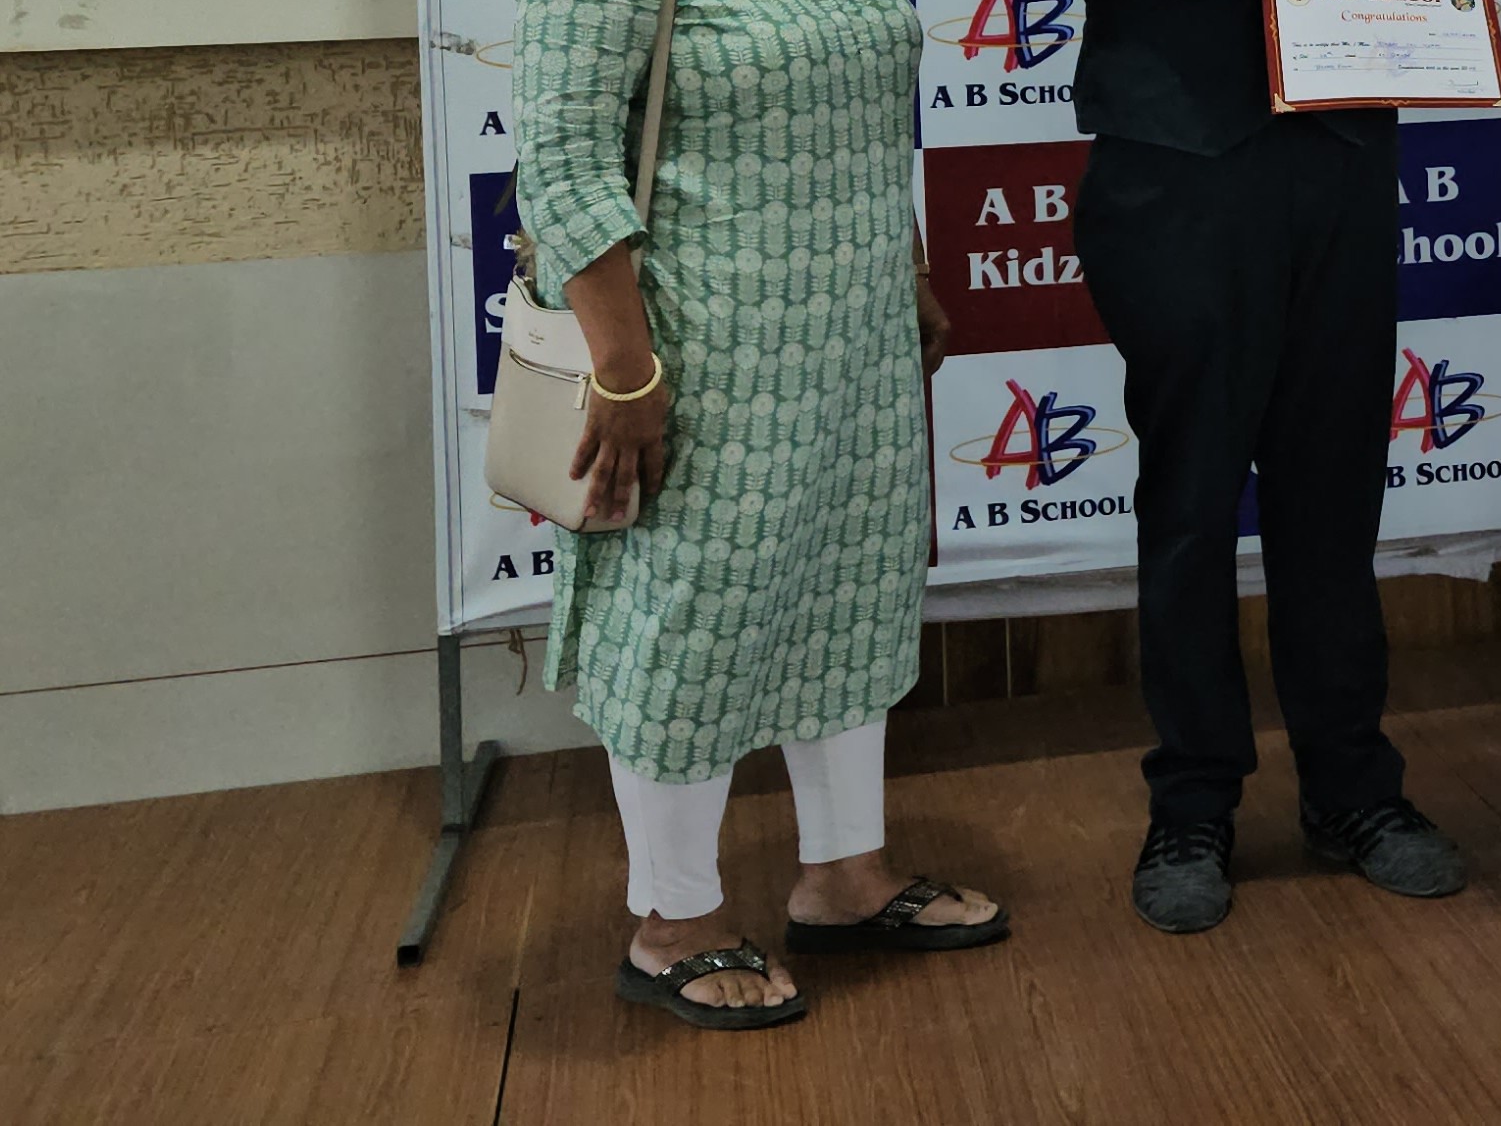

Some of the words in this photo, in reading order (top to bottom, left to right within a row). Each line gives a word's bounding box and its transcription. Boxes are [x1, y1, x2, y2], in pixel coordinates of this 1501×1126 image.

[1341, 9, 1428, 24] Congratulations
[930, 85, 955, 109] A
[965, 83, 988, 107] B
[479, 111, 507, 136] A
[1424, 165, 1460, 204] B
[975, 187, 1015, 226] A
[1033, 184, 1069, 222] B
[967, 245, 1085, 291] Kidz
[1387, 465, 1406, 489] B
[952, 505, 976, 531] A
[988, 502, 1010, 527] B
[491, 554, 520, 581] A
[531, 550, 554, 576] B
